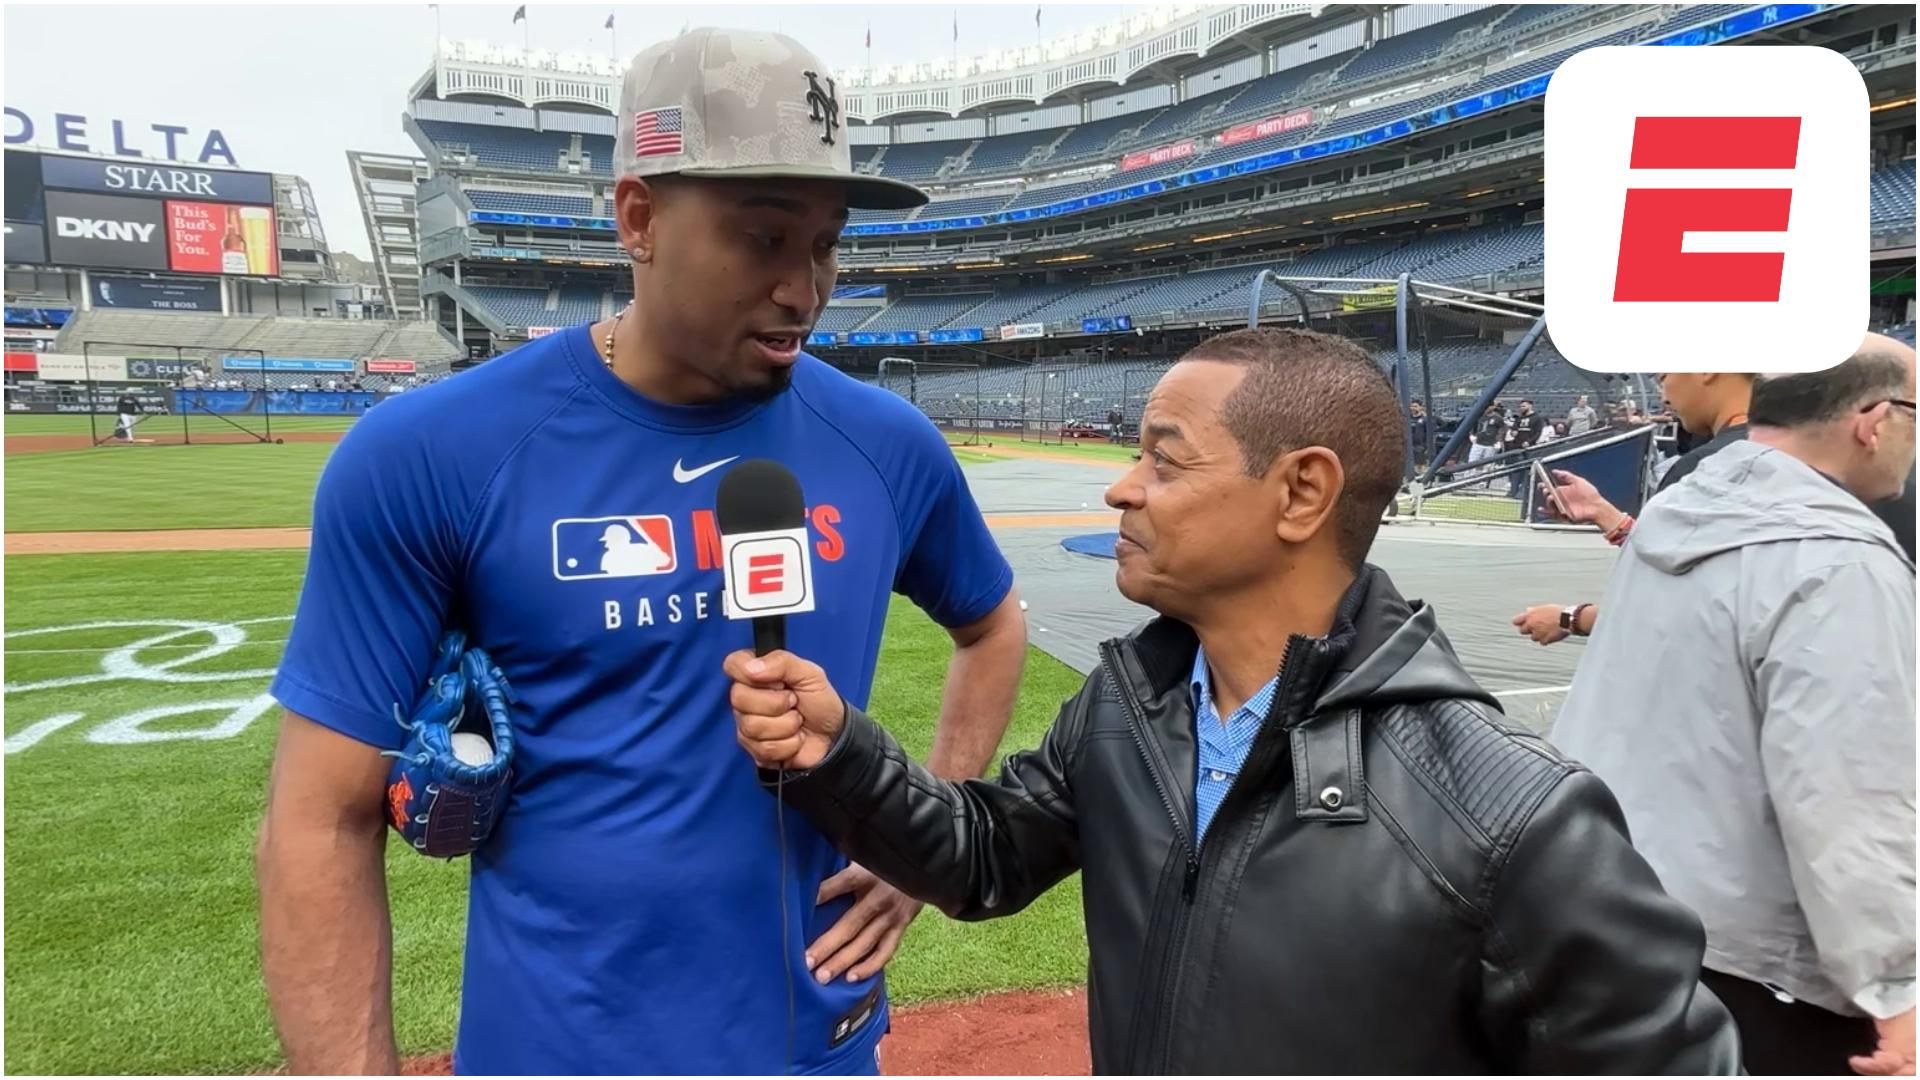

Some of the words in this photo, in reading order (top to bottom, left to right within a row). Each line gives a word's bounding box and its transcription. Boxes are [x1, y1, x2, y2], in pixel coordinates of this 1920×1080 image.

[1257, 118, 1283, 135] PARTY
[1284, 112, 1309, 129] DECK
[4, 106, 237, 166] DELTA
[1150, 147, 1172, 162] PARTY
[1172, 143, 1193, 158] DECK
[105, 165, 217, 195] STARR
[172, 204, 209, 218] This
[56, 216, 156, 243] DKNY
[175, 217, 217, 231] Bud's
[175, 230, 203, 242] For
[176, 242, 210, 255] You.
[151, 300, 171, 308] THE
[173, 301, 198, 309] BOSS
[691, 503, 845, 570] MS
